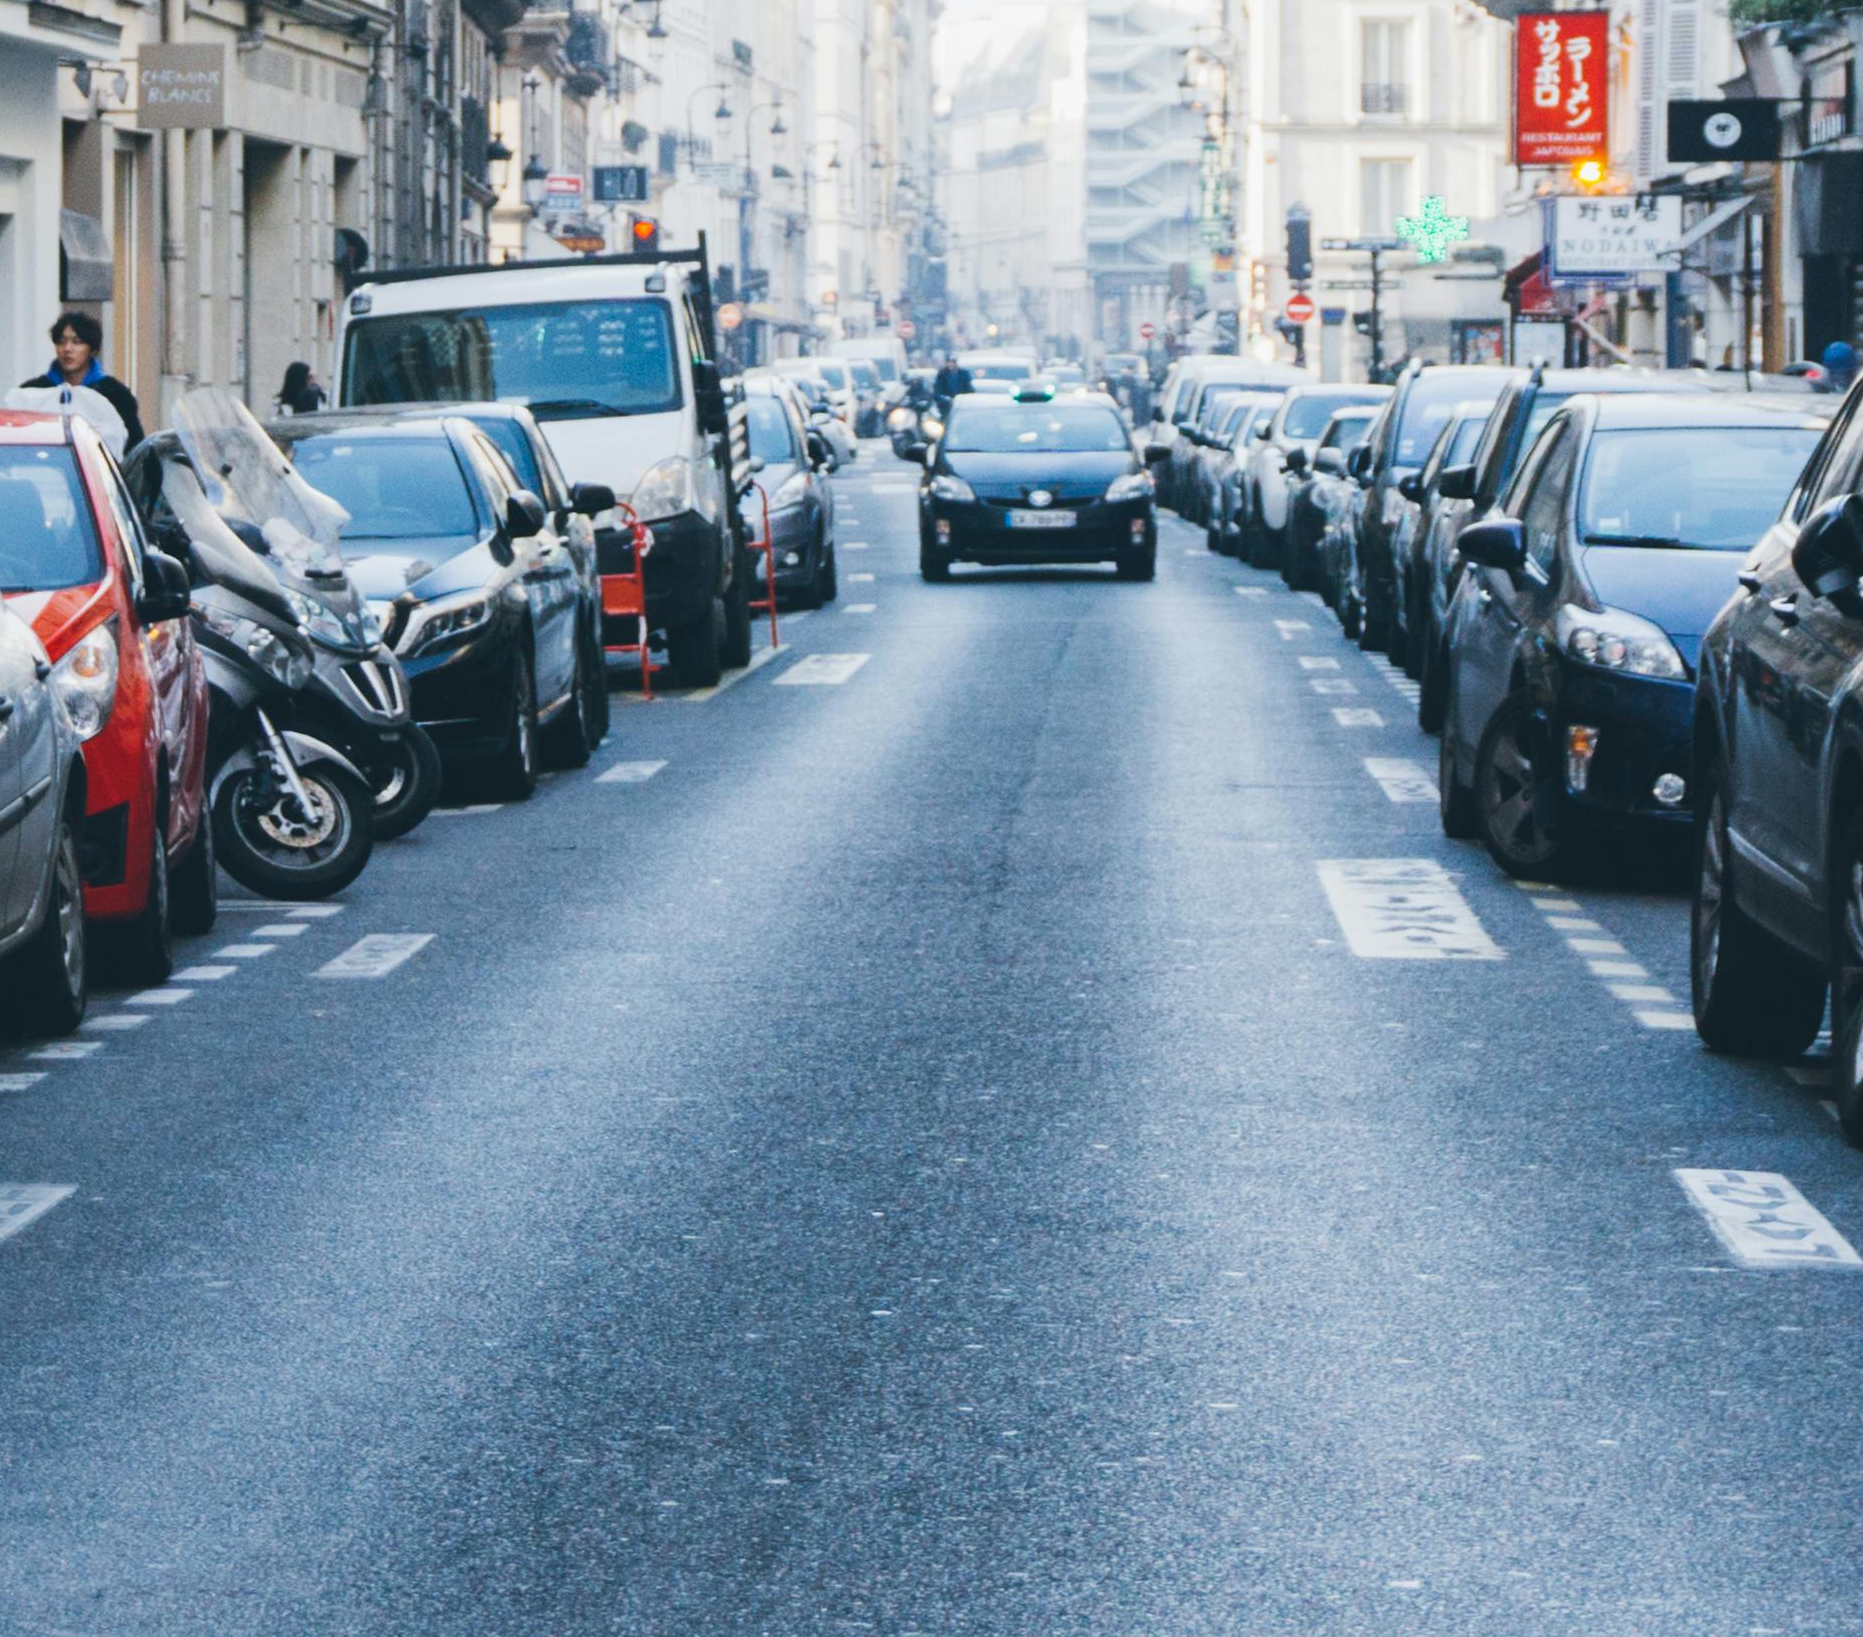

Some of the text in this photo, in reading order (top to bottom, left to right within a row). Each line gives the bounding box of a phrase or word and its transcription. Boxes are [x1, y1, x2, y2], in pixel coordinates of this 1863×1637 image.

[1534, 19, 1561, 107] サッポロ
[1566, 36, 1592, 128] ラーメン
